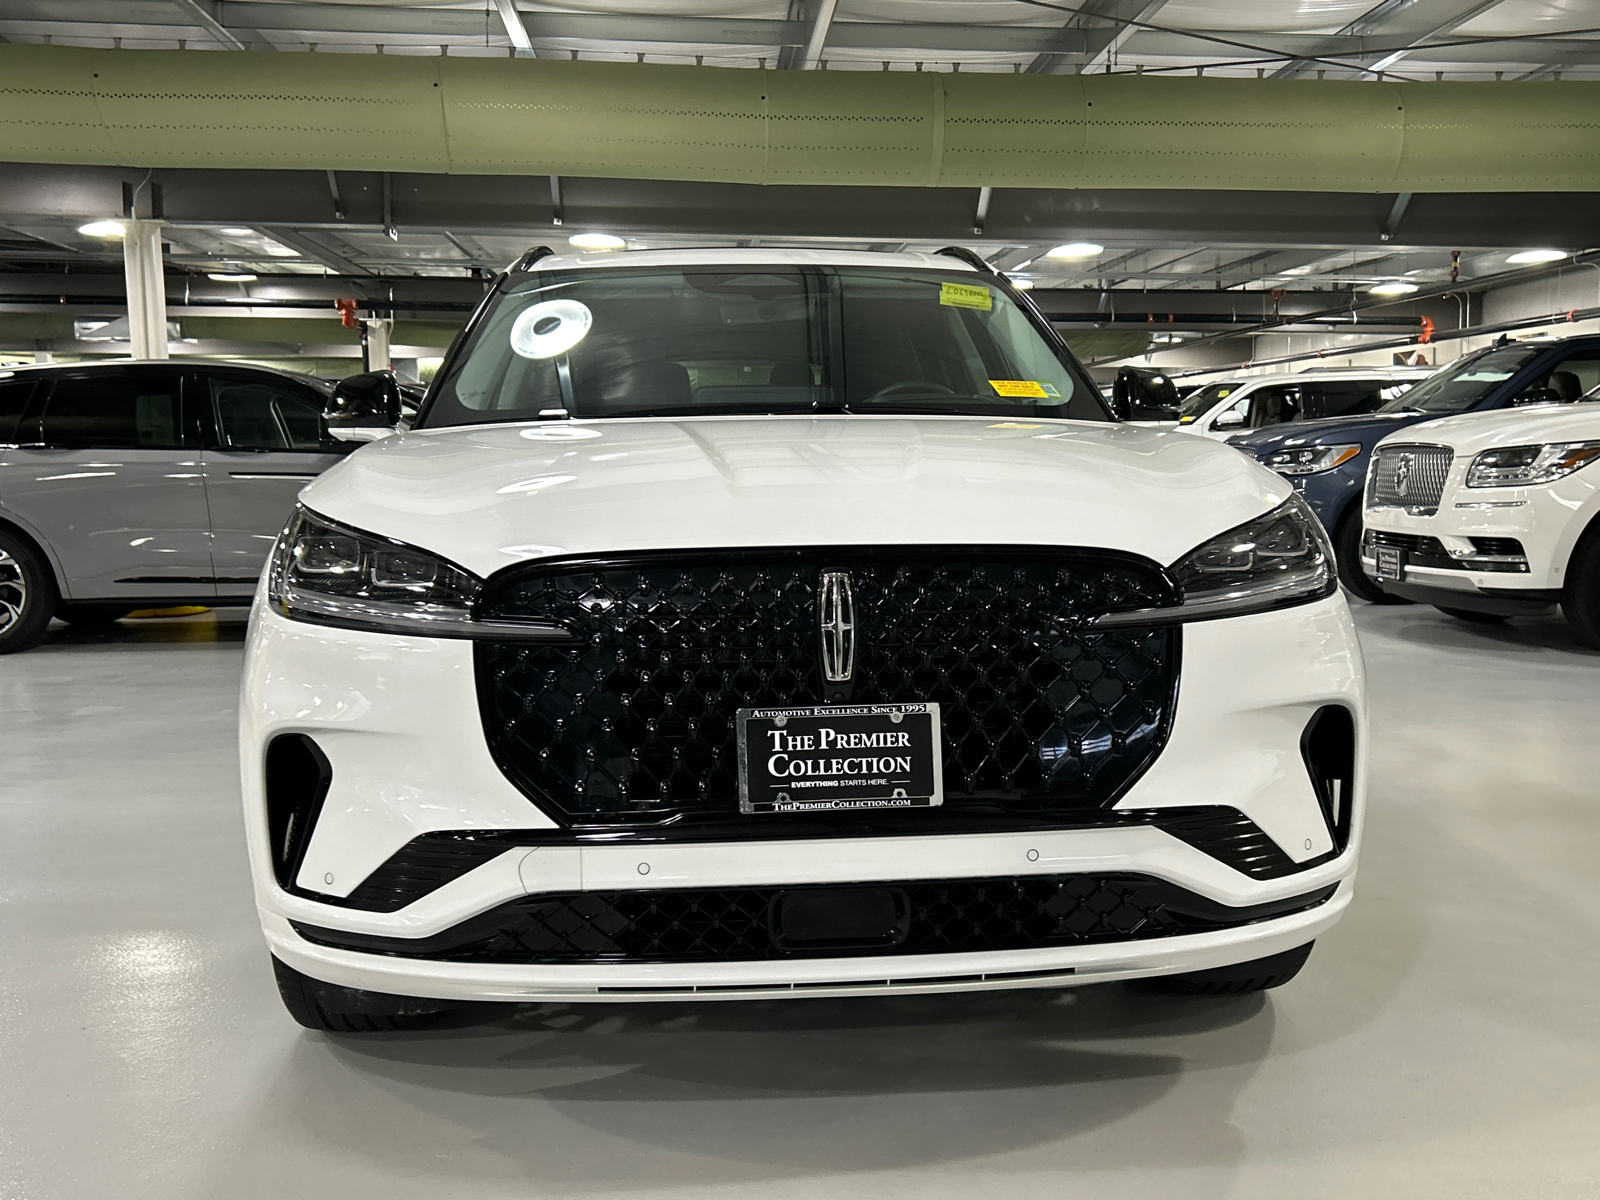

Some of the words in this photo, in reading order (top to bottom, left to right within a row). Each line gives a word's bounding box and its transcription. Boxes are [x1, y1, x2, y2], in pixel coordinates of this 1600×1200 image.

[752, 709, 812, 718] AUTOMOTIVE
[814, 707, 869, 715] EXCELLENCE
[871, 706, 898, 714] SINCE
[900, 705, 925, 713] 1995
[767, 730, 815, 752] THE
[818, 728, 911, 750] PREMIER
[767, 754, 912, 777] COLLECTION
